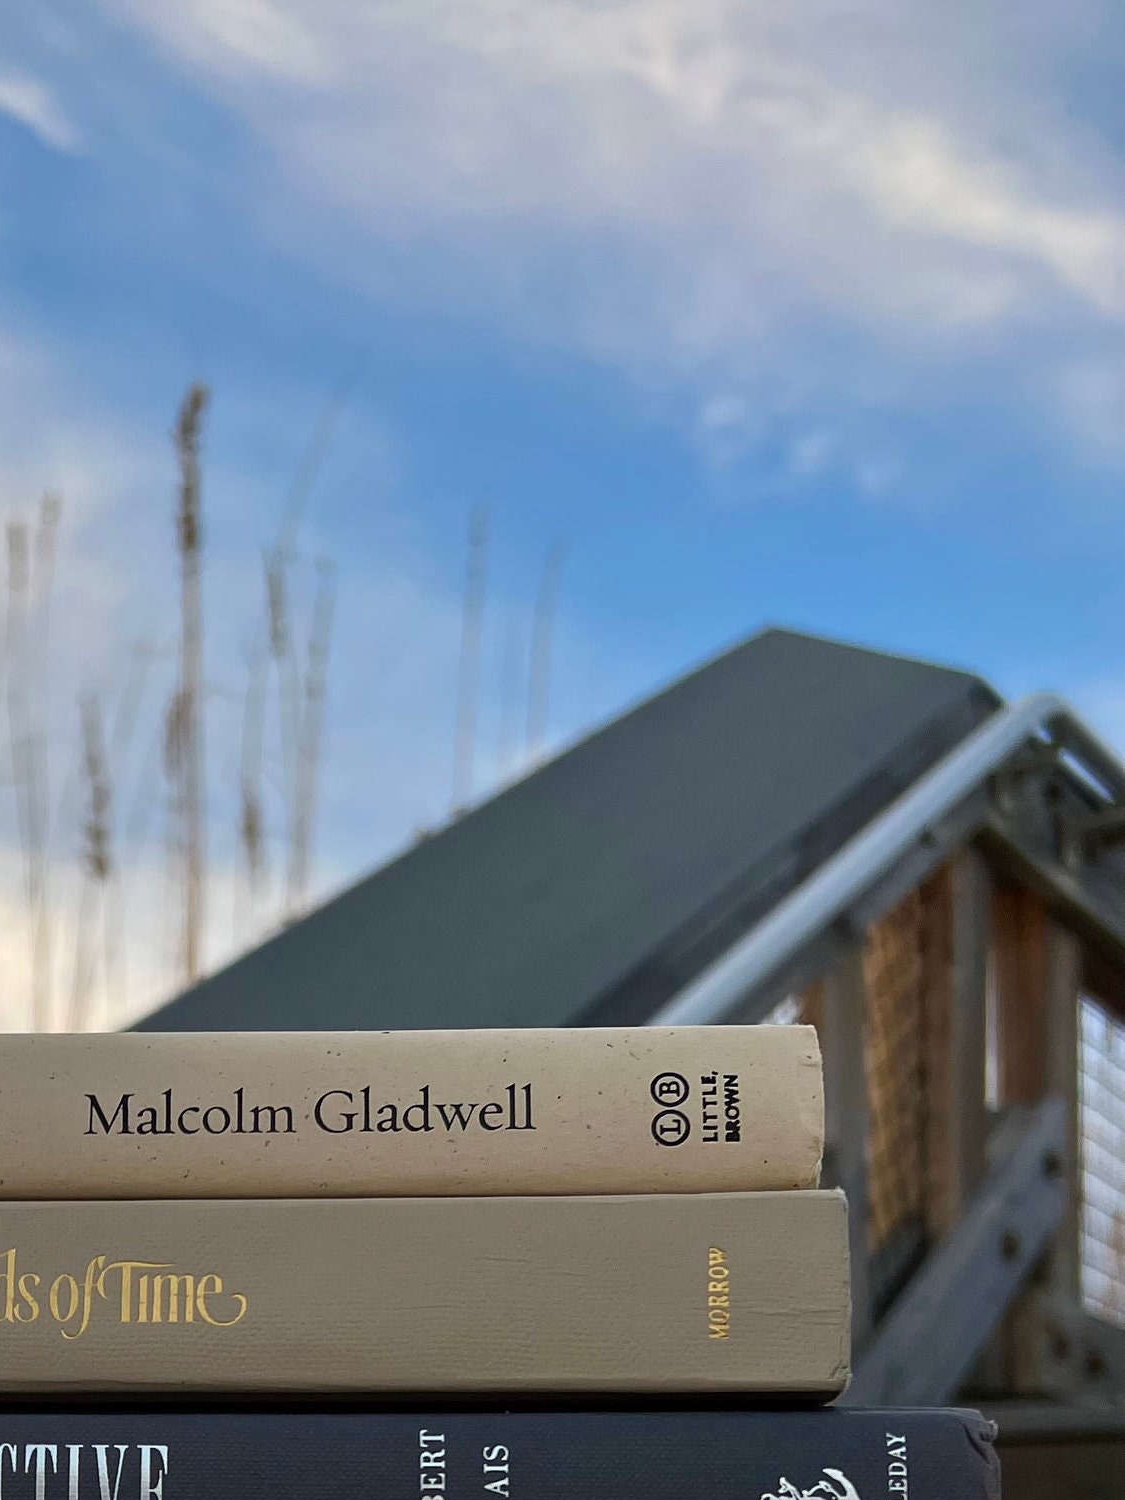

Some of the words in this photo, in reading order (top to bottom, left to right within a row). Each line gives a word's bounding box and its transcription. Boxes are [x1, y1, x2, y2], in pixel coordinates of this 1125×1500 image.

[83, 1088, 297, 1136] Malcolm
[314, 1083, 536, 1133] Gladwell
[701, 1071, 719, 1142] LITTLE,
[723, 1074, 741, 1142] BROWN
[49, 1255, 107, 1340] of
[97, 1261, 247, 1326] Time
[707, 1247, 730, 1339] MORROW
